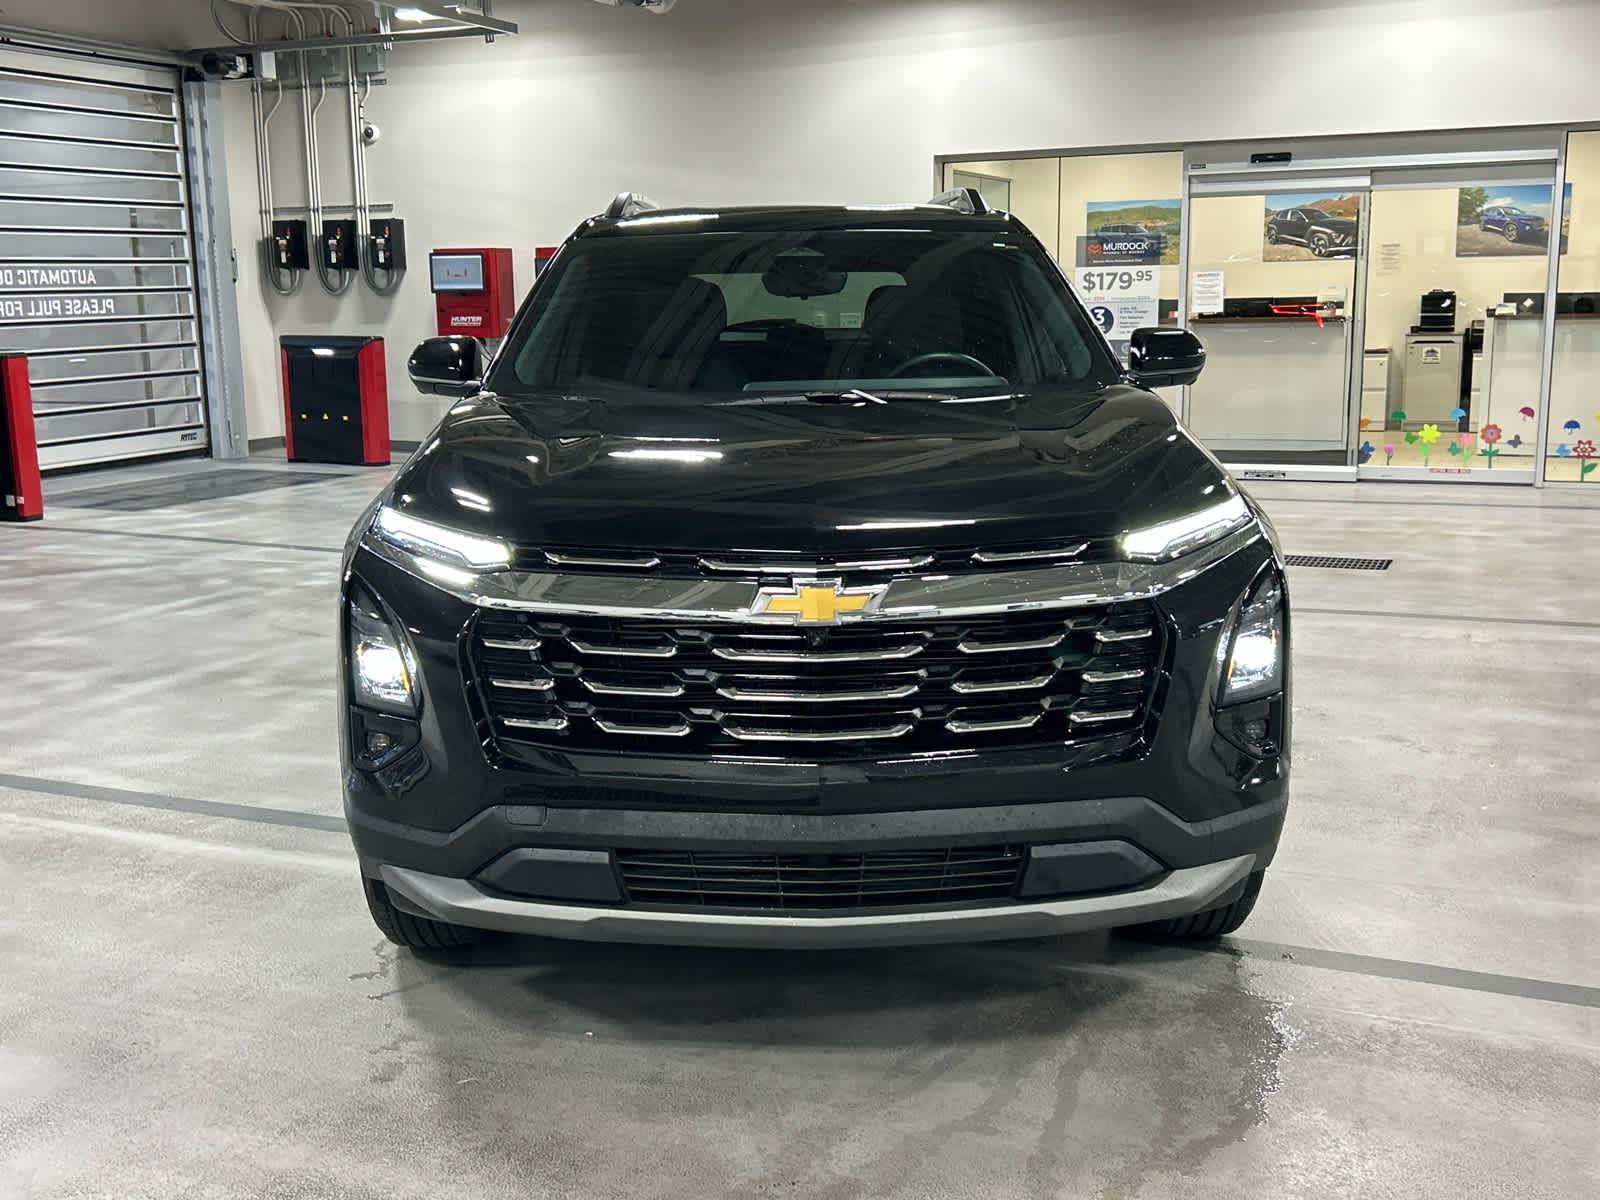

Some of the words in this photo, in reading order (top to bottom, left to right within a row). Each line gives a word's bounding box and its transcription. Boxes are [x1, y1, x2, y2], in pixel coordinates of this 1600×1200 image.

[1103, 241, 1150, 251] MURDOCK
[1083, 270, 1153, 293] $179.95
[451, 315, 483, 323] HUNTER
[1094, 308, 1106, 325] 3
